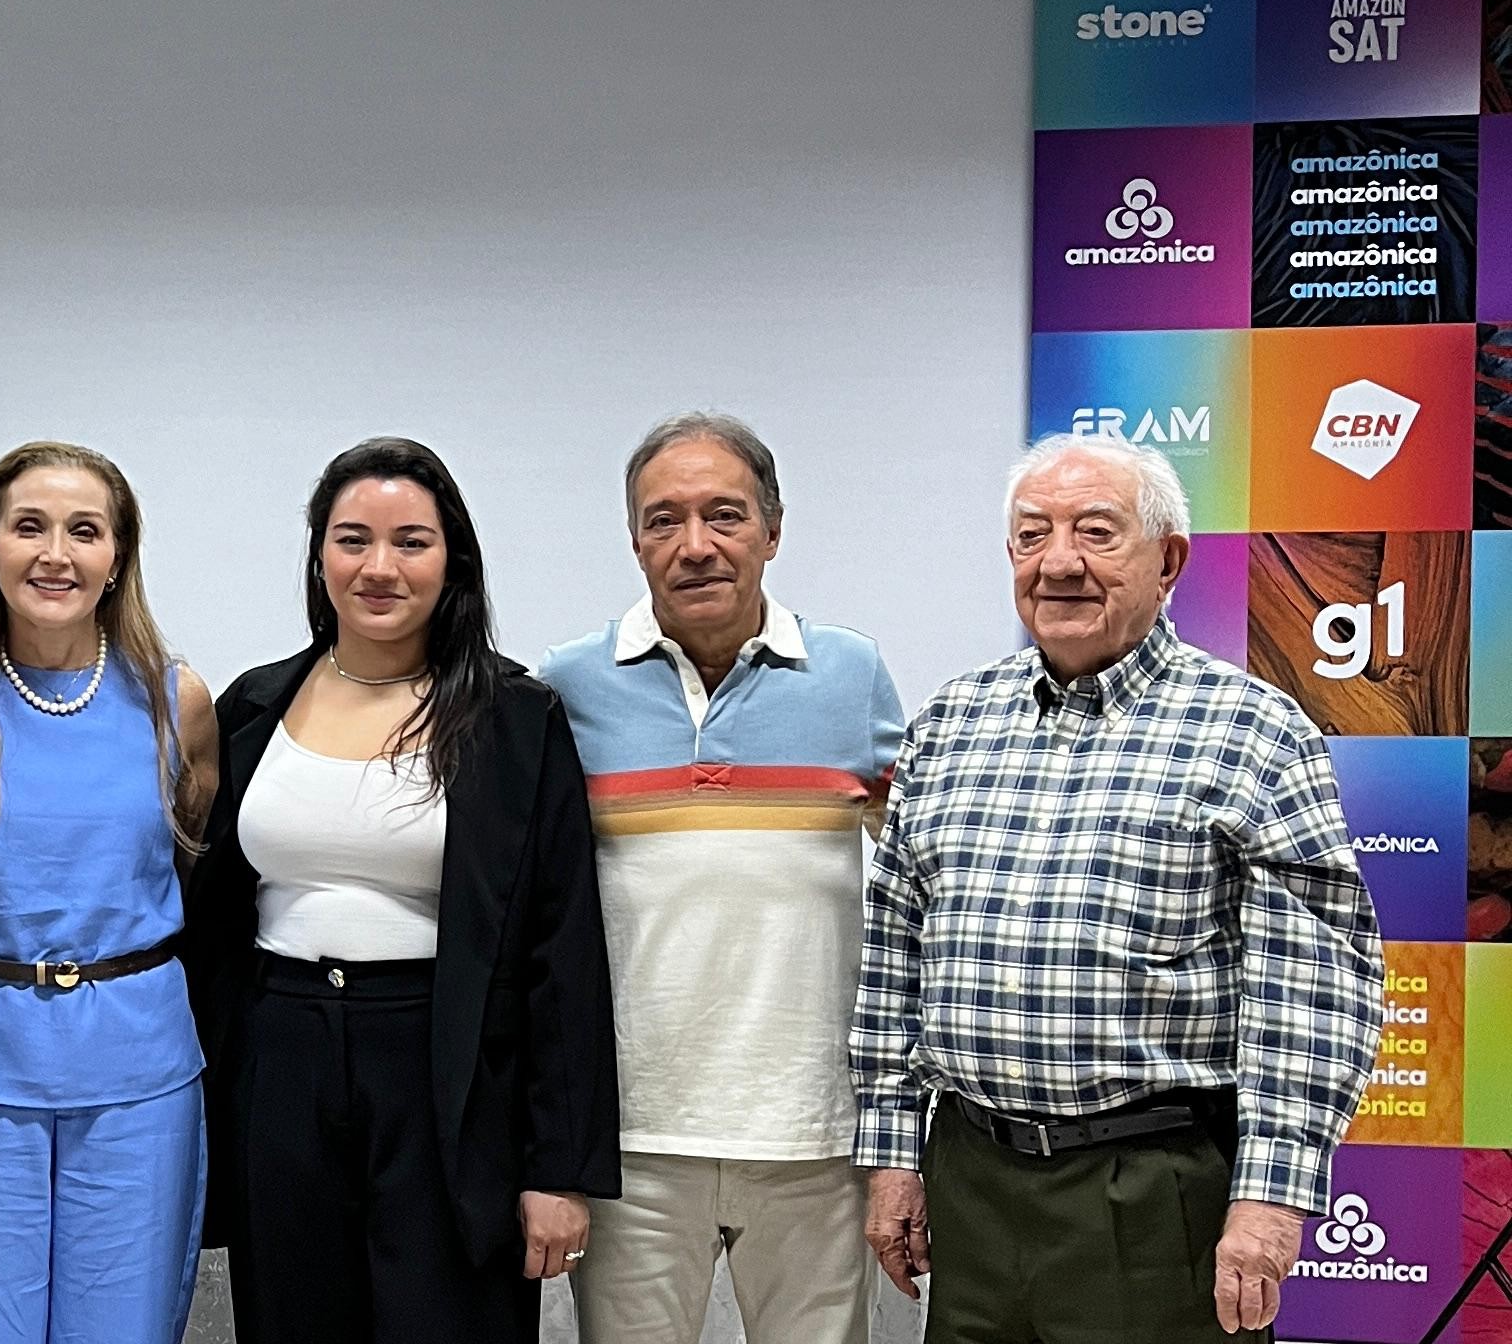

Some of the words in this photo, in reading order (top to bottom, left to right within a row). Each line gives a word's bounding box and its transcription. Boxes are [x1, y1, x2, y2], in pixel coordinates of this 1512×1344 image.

[1076, 4, 1206, 40] stone
[1328, 17, 1406, 64] SAT
[1291, 147, 1438, 173] amazônica
[1290, 178, 1438, 205] amazônica
[1290, 210, 1438, 236] amazônica
[1065, 239, 1215, 265] amazônica
[1289, 241, 1437, 268] amazônica
[1289, 273, 1437, 299] amazônica
[1072, 406, 1210, 442] FRAM
[1327, 413, 1402, 438] CBN
[1311, 581, 1406, 679] g1
[1288, 1258, 1428, 1282] mazônica
